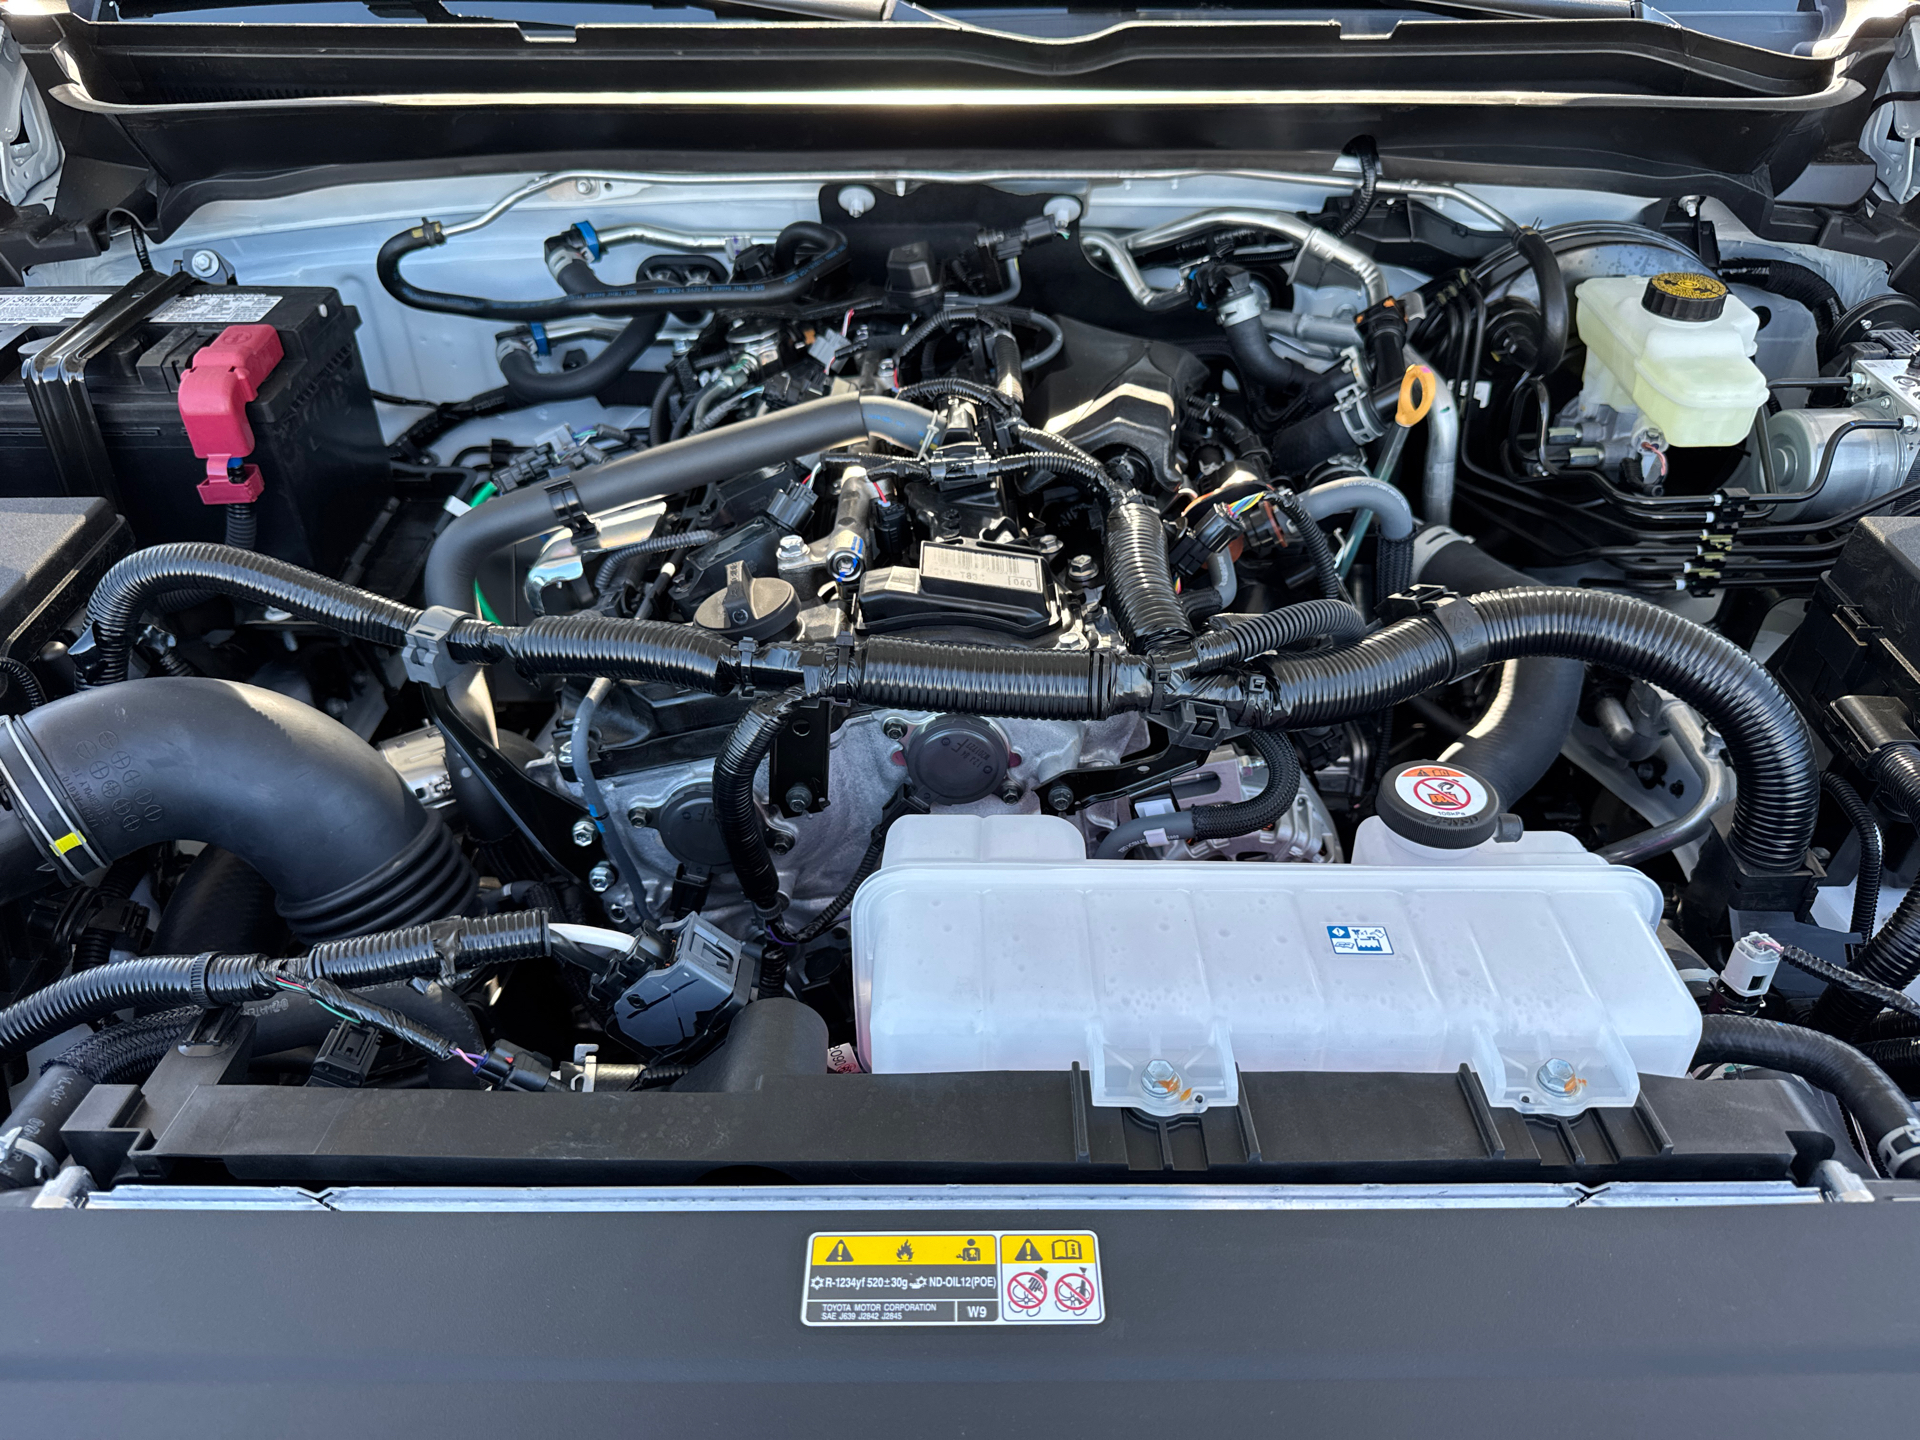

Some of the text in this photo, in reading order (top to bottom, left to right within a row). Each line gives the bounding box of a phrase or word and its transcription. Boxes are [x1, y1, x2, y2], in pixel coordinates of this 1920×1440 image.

[1013, 578, 1033, 588] 040
[824, 1275, 997, 1290] R-1234yf 520±30g ND-OIL12(POE)
[822, 1302, 937, 1312] TOYOTA MOTOR CORPORATION
[967, 1305, 987, 1318] W9
[821, 1312, 903, 1321] SAE J639 J2842 J2845
